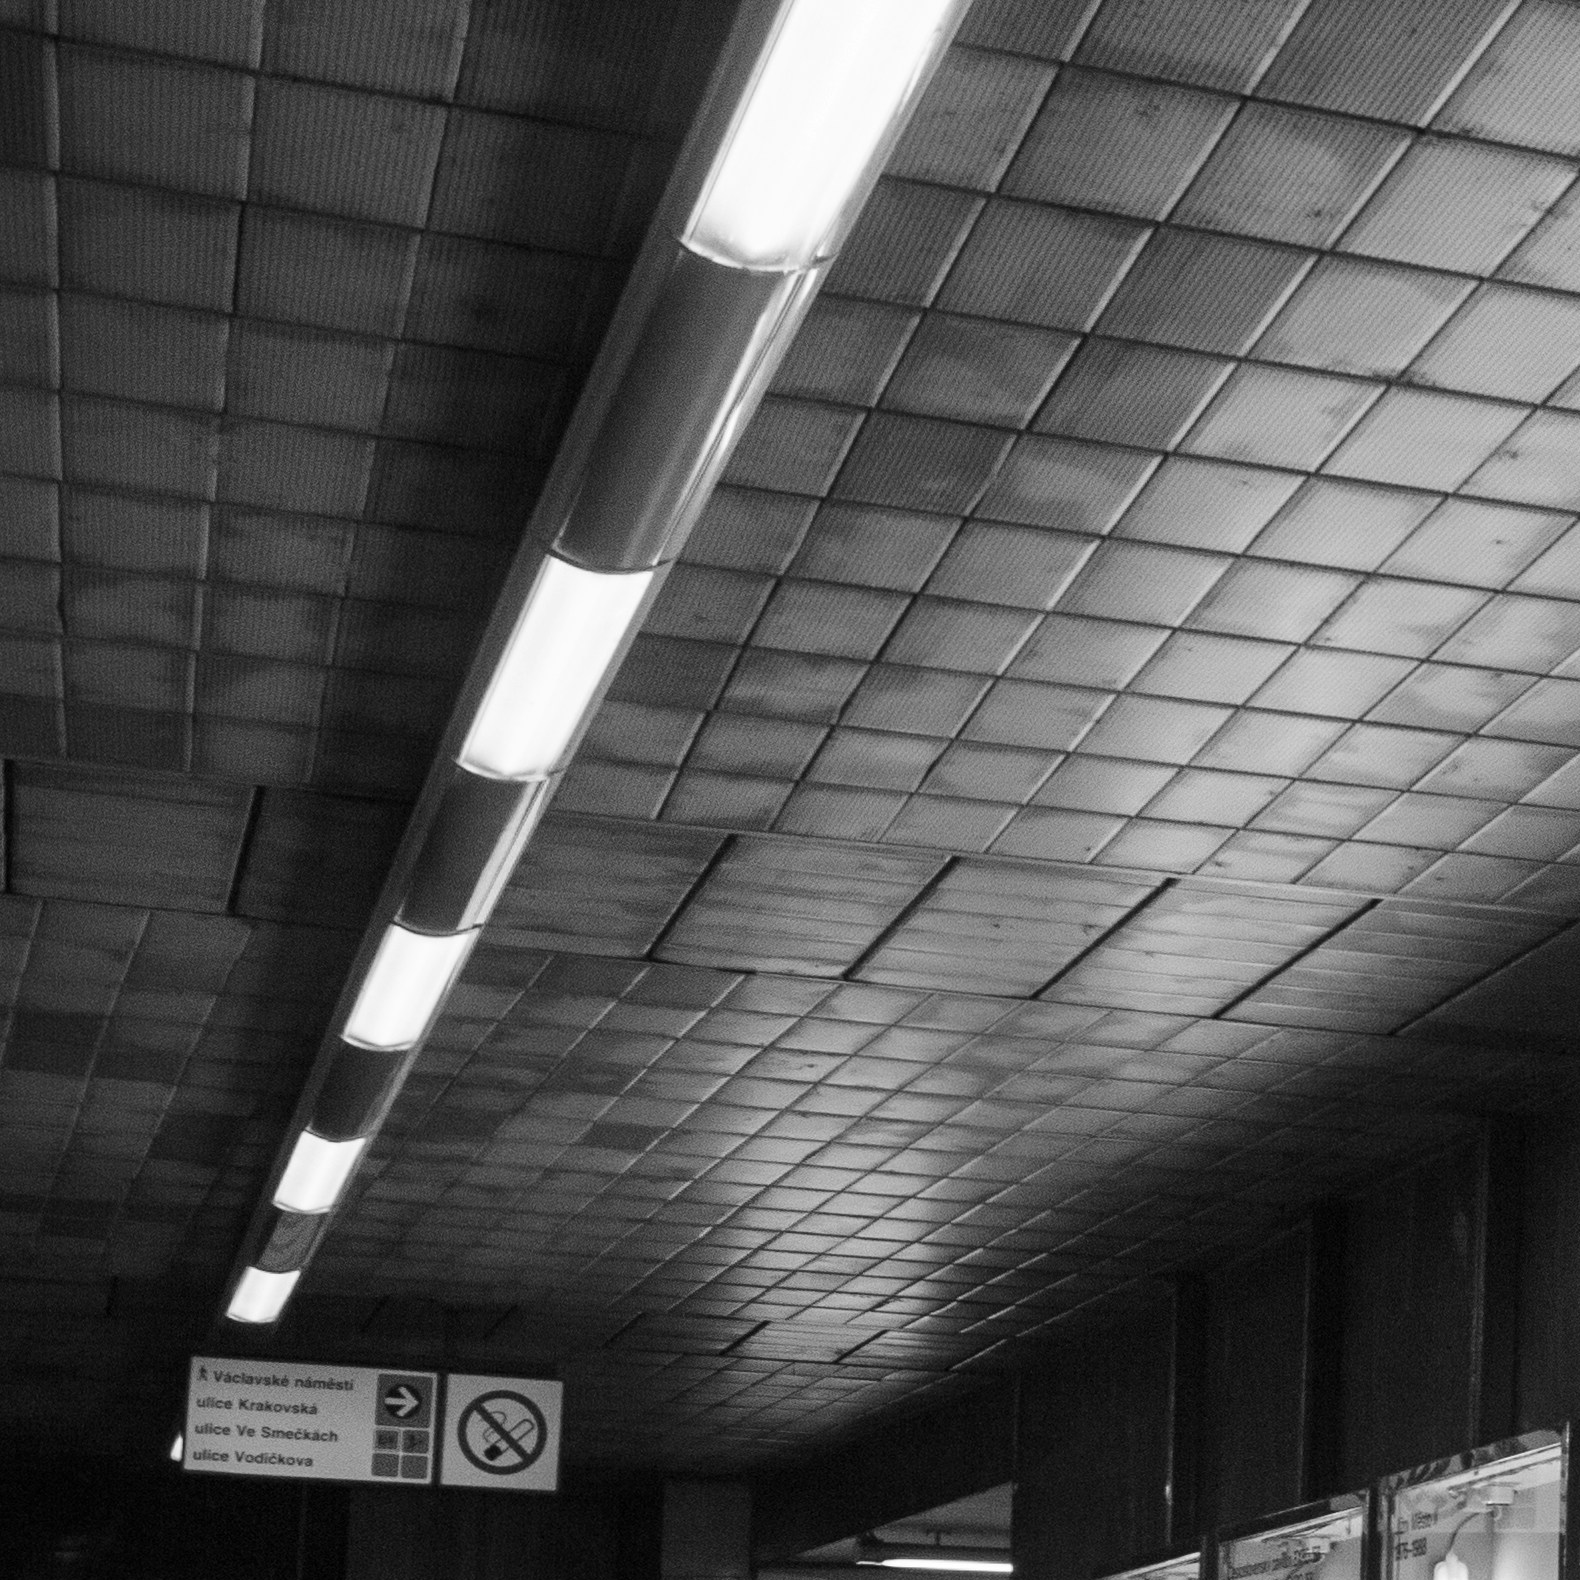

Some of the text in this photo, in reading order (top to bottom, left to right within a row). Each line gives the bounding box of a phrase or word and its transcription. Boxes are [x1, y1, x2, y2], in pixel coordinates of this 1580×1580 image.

[213, 1370, 354, 1391] Václavské náměstí
[196, 1396, 318, 1415] ulice Krakovská
[194, 1423, 338, 1442] ulice Ve Smečkách
[193, 1449, 313, 1467] ulice Vodičkova
